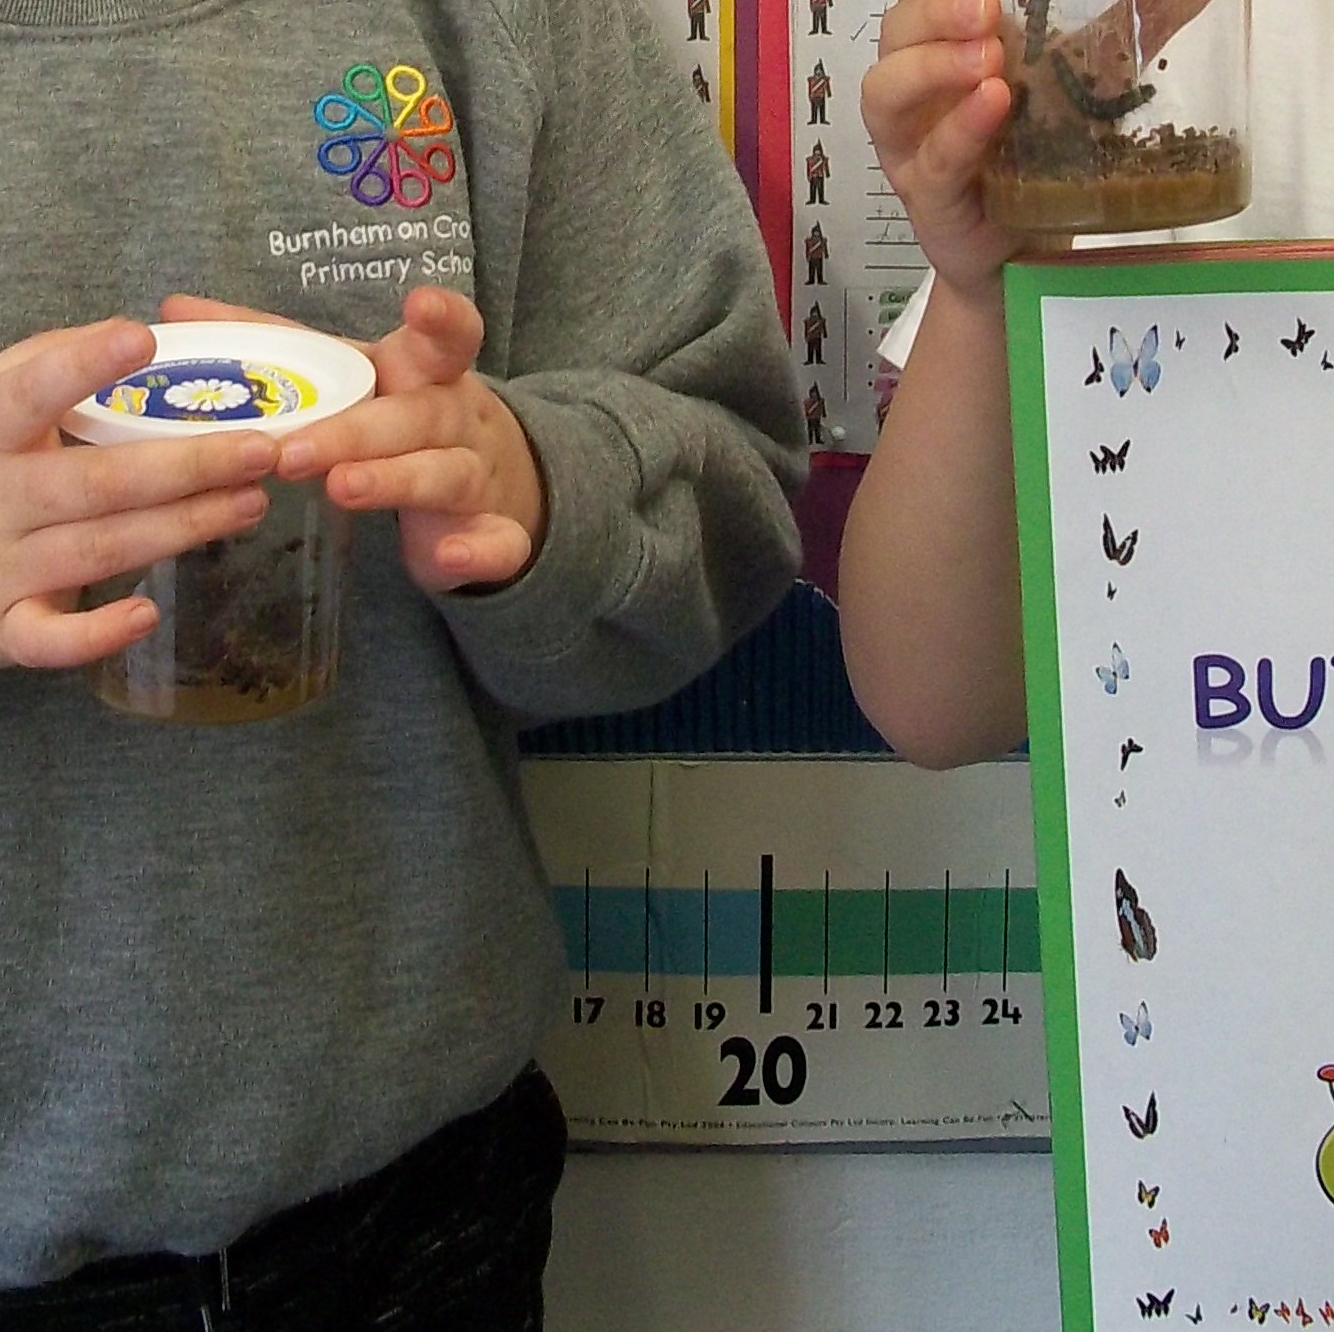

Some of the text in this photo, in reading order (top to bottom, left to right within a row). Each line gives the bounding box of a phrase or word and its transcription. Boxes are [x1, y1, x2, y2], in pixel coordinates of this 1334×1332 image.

[269, 215, 470, 256] Burnham on Cro
[301, 251, 473, 287] Primary Scho
[573, 997, 1022, 1030] 17 18 19 21 22 23 24
[717, 1035, 807, 1105] 20
